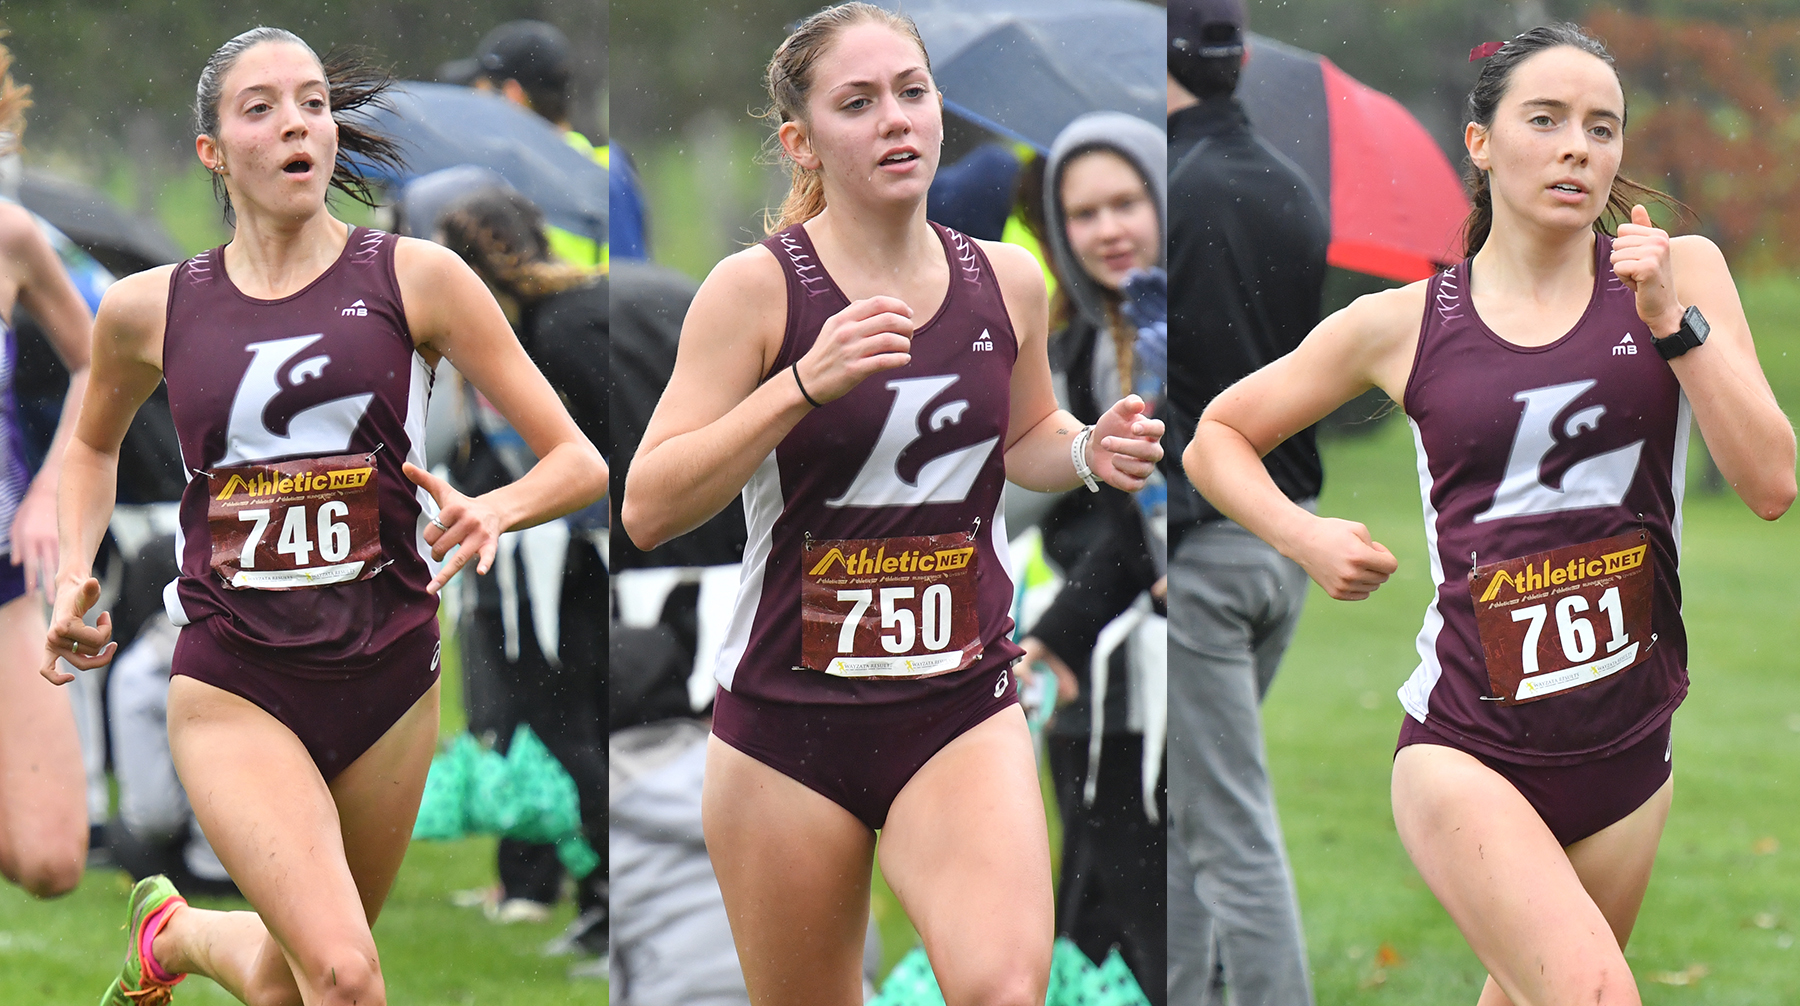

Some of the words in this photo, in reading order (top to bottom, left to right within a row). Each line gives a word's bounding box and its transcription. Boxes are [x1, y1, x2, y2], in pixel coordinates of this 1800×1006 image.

[238, 500, 351, 568] 746
[809, 546, 936, 575] Athletic
[938, 551, 969, 567] NET
[1479, 557, 1603, 602] Athletic
[1607, 549, 1643, 570] NET
[837, 583, 952, 653] 750
[1511, 586, 1629, 674] 761
